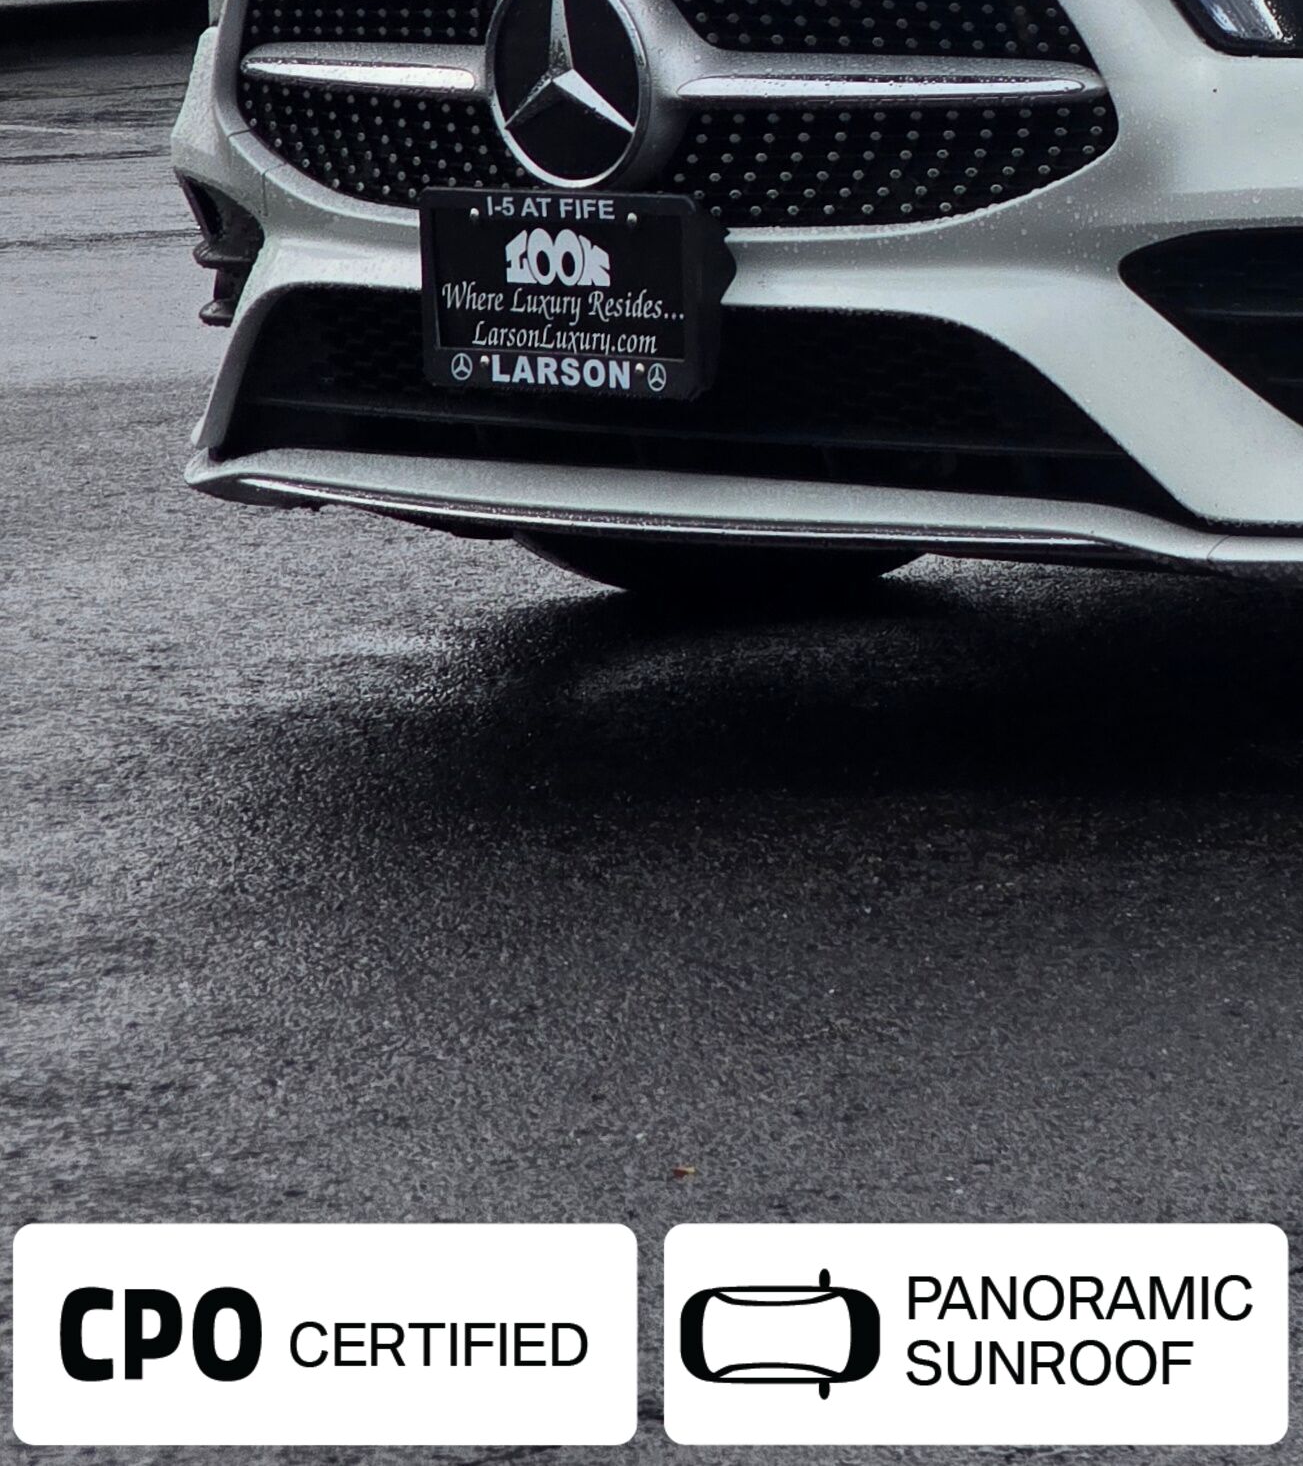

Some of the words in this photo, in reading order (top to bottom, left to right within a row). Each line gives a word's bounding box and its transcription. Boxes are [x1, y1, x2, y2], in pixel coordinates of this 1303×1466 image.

[487, 196, 515, 216] I-5
[521, 198, 551, 217] AT
[560, 198, 615, 220] FIFE
[442, 281, 504, 311] Where
[510, 287, 582, 326] Luxury
[588, 289, 685, 322] Resides...
[472, 320, 657, 355] LarsonLuxury.com
[491, 354, 630, 389] LARSON
